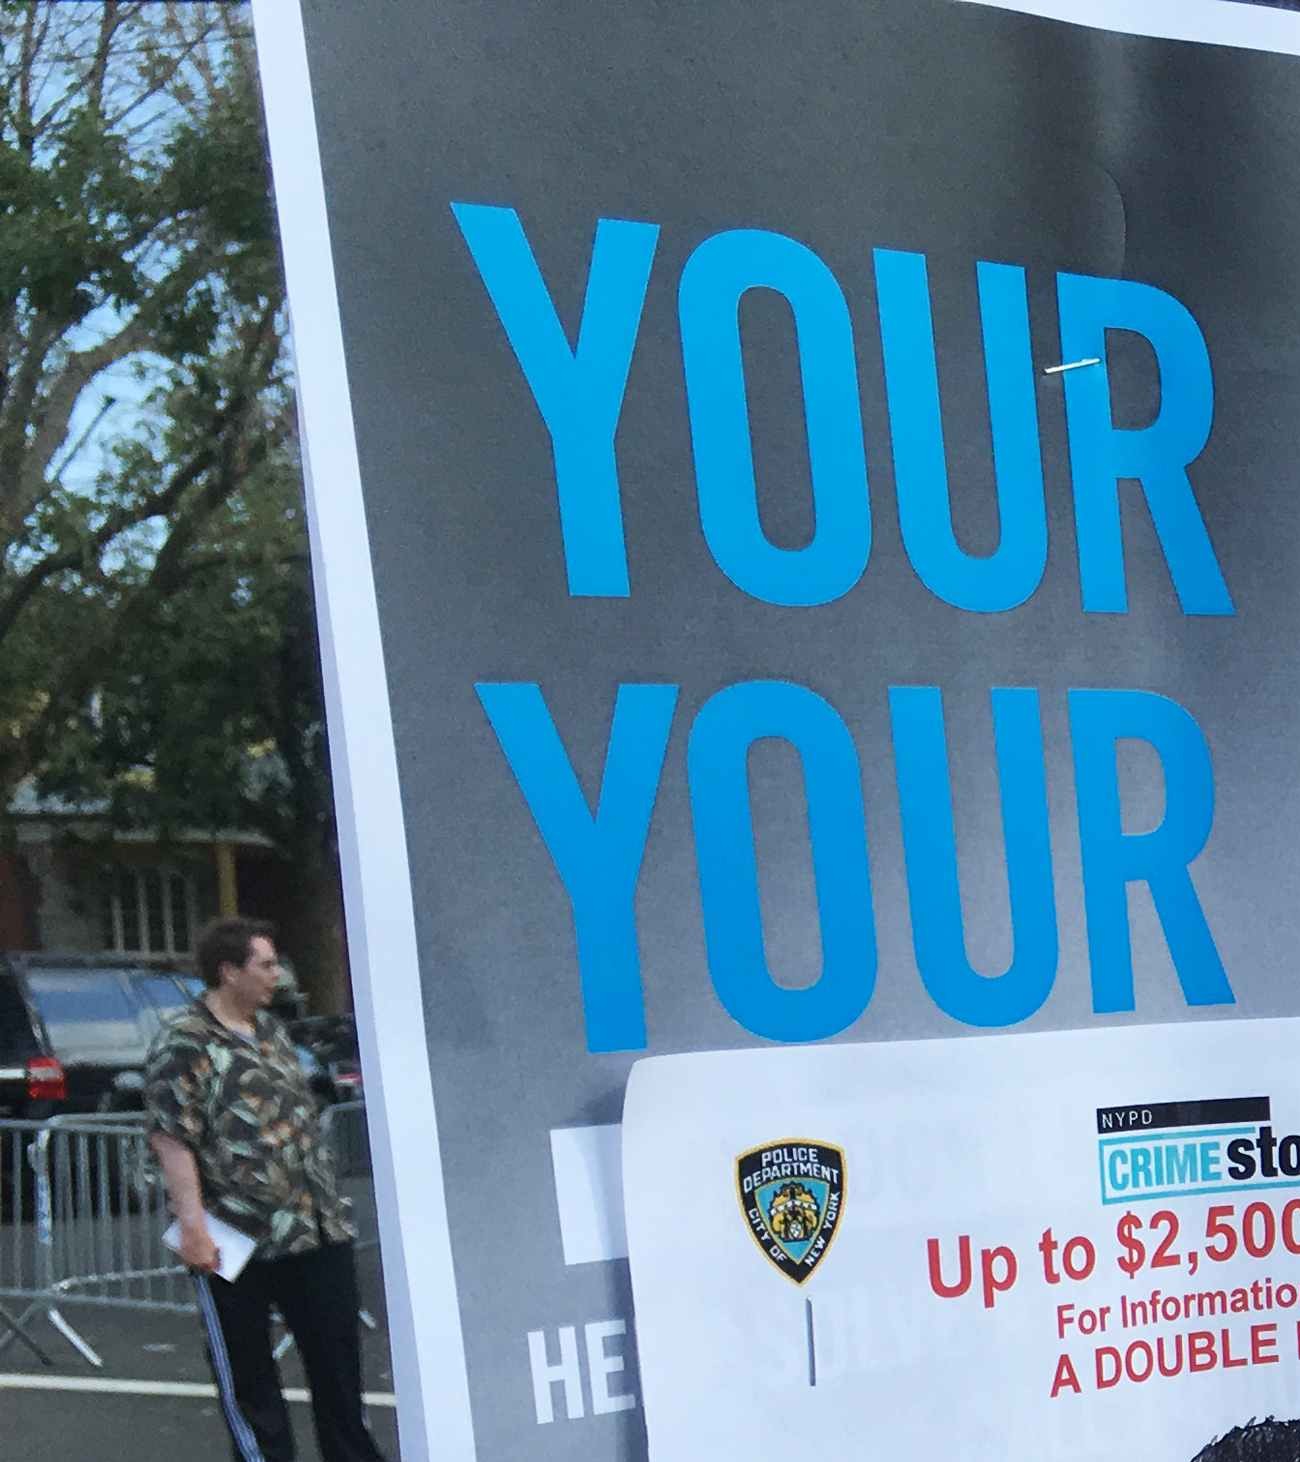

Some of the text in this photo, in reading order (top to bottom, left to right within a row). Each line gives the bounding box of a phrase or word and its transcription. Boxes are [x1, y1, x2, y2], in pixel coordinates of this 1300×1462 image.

[449, 201, 1237, 617] YOUR
[475, 681, 1237, 1054] YOUR
[1102, 1109, 1153, 1129] NYPD
[743, 1163, 839, 1193] DEPARTMENT
[761, 1147, 818, 1167] POLICE
[1108, 1141, 1222, 1192] CRIME
[749, 1208, 788, 1263] CITY OF
[804, 1191, 840, 1266] NEW YORK
[926, 1235, 1018, 1308] Up
[1038, 1228, 1096, 1285] to
[1056, 1302, 1110, 1339] For
[1049, 1355, 1082, 1398] A
[1095, 1323, 1280, 1390] DOUBLE
